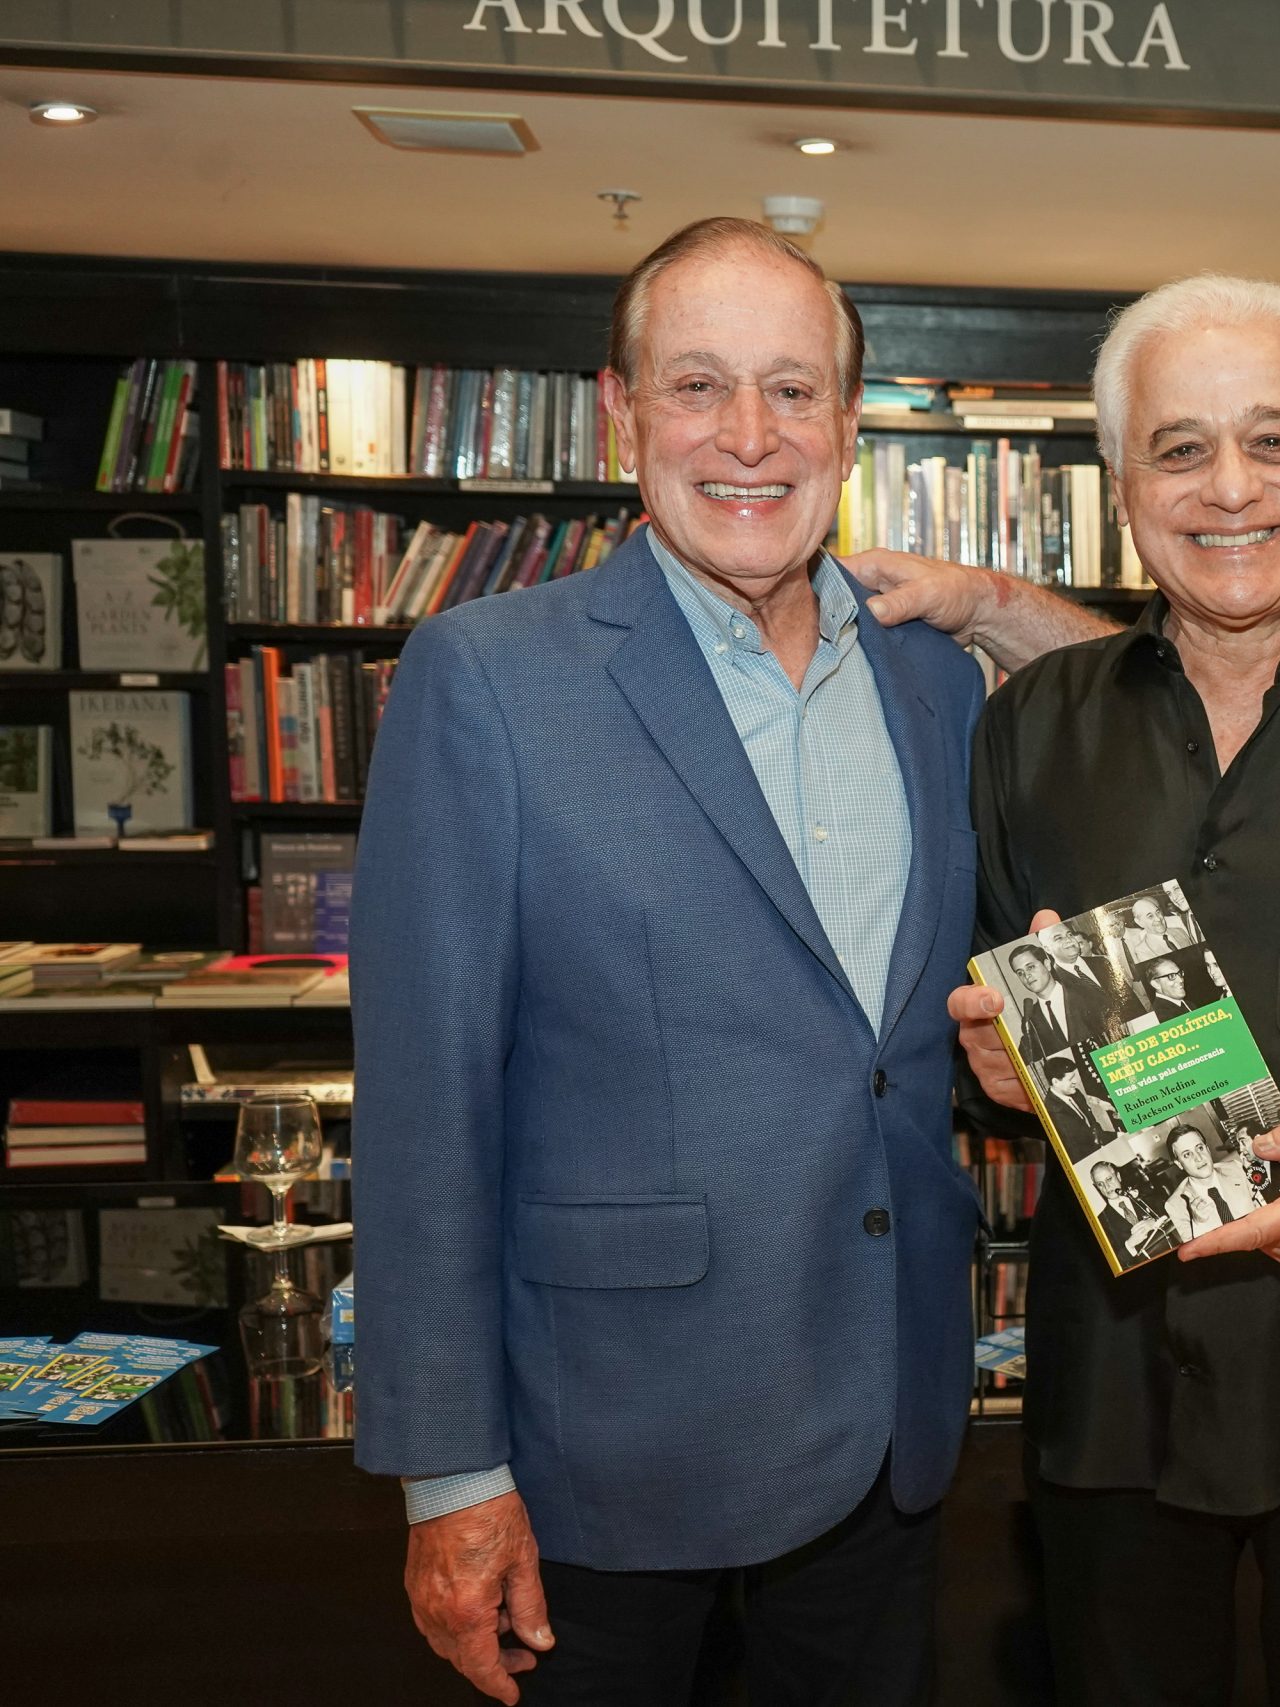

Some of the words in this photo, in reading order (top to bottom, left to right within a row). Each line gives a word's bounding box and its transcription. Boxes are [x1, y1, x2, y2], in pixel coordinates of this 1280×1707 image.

[79, 696, 170, 713] IKEBANA
[1099, 1044, 1136, 1068] ISTO
[1136, 1036, 1160, 1053] DE
[1158, 1008, 1233, 1043] POLÍTICA,
[1106, 1059, 1145, 1084] MEU
[1146, 1043, 1200, 1067] CARO...
[1114, 1083, 1138, 1097] Uma
[1138, 1074, 1158, 1088] vida
[1158, 1066, 1177, 1081] pela
[1177, 1046, 1226, 1072] democracia
[1123, 1094, 1159, 1113] Rubem
[1160, 1078, 1197, 1098] Medina
[1174, 1078, 1230, 1106] Vasconcelos
